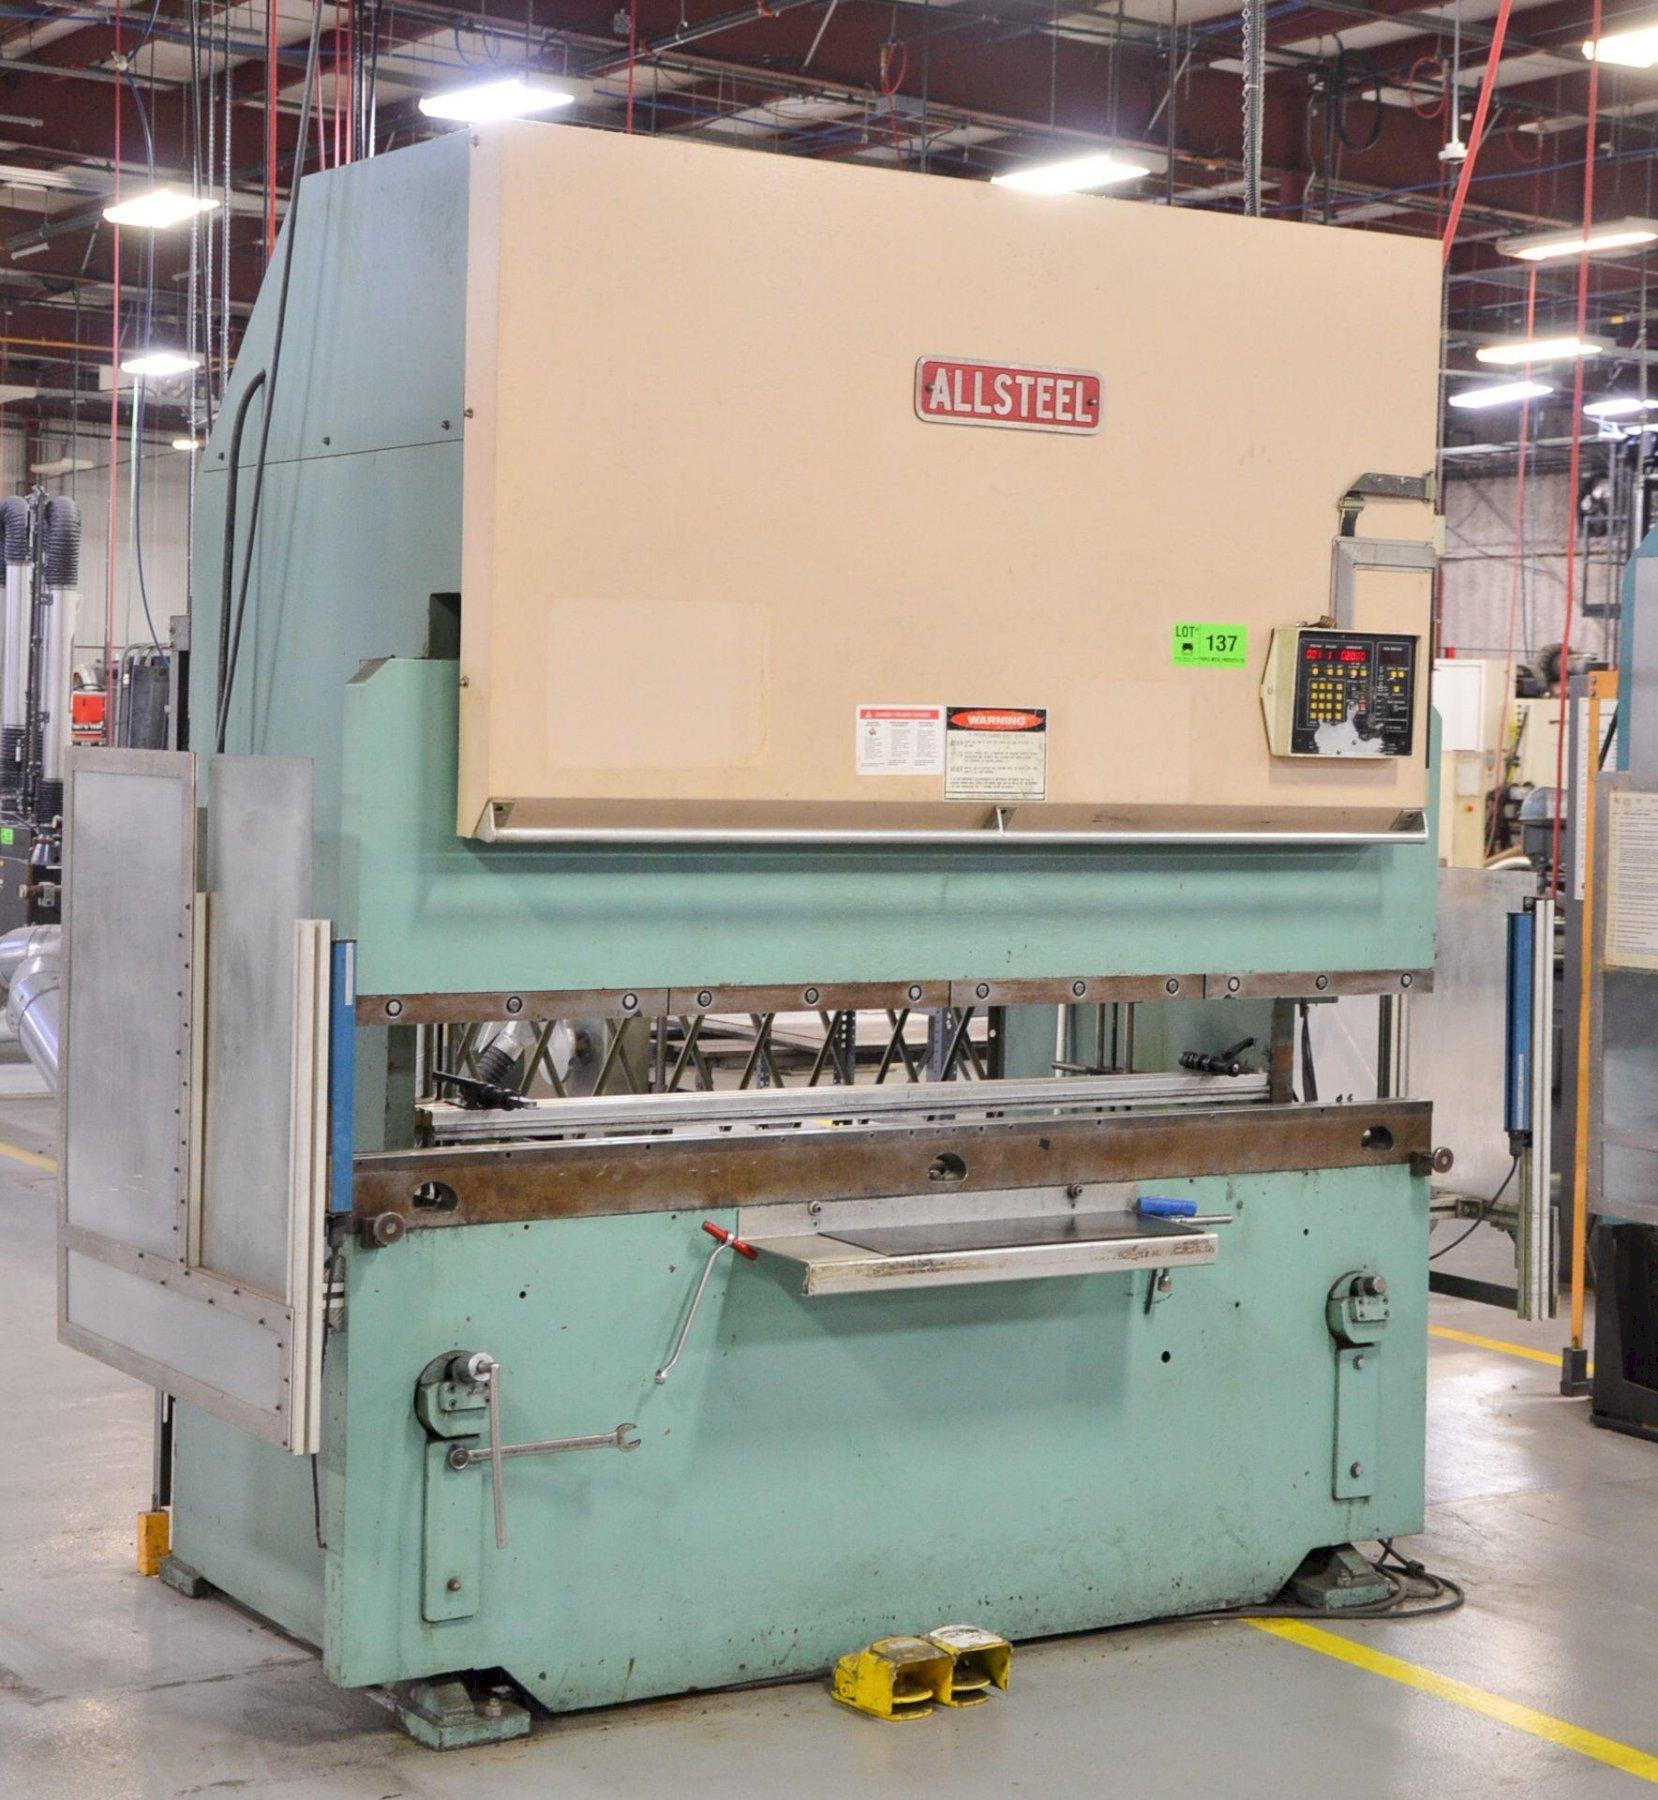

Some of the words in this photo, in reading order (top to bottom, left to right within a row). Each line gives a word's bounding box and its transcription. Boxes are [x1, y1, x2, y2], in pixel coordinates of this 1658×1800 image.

[929, 367, 1092, 422] ALLSTEEL
[1175, 625, 1195, 637] LOT
[1205, 634, 1238, 652] 137
[967, 715, 1027, 726] WARNING
